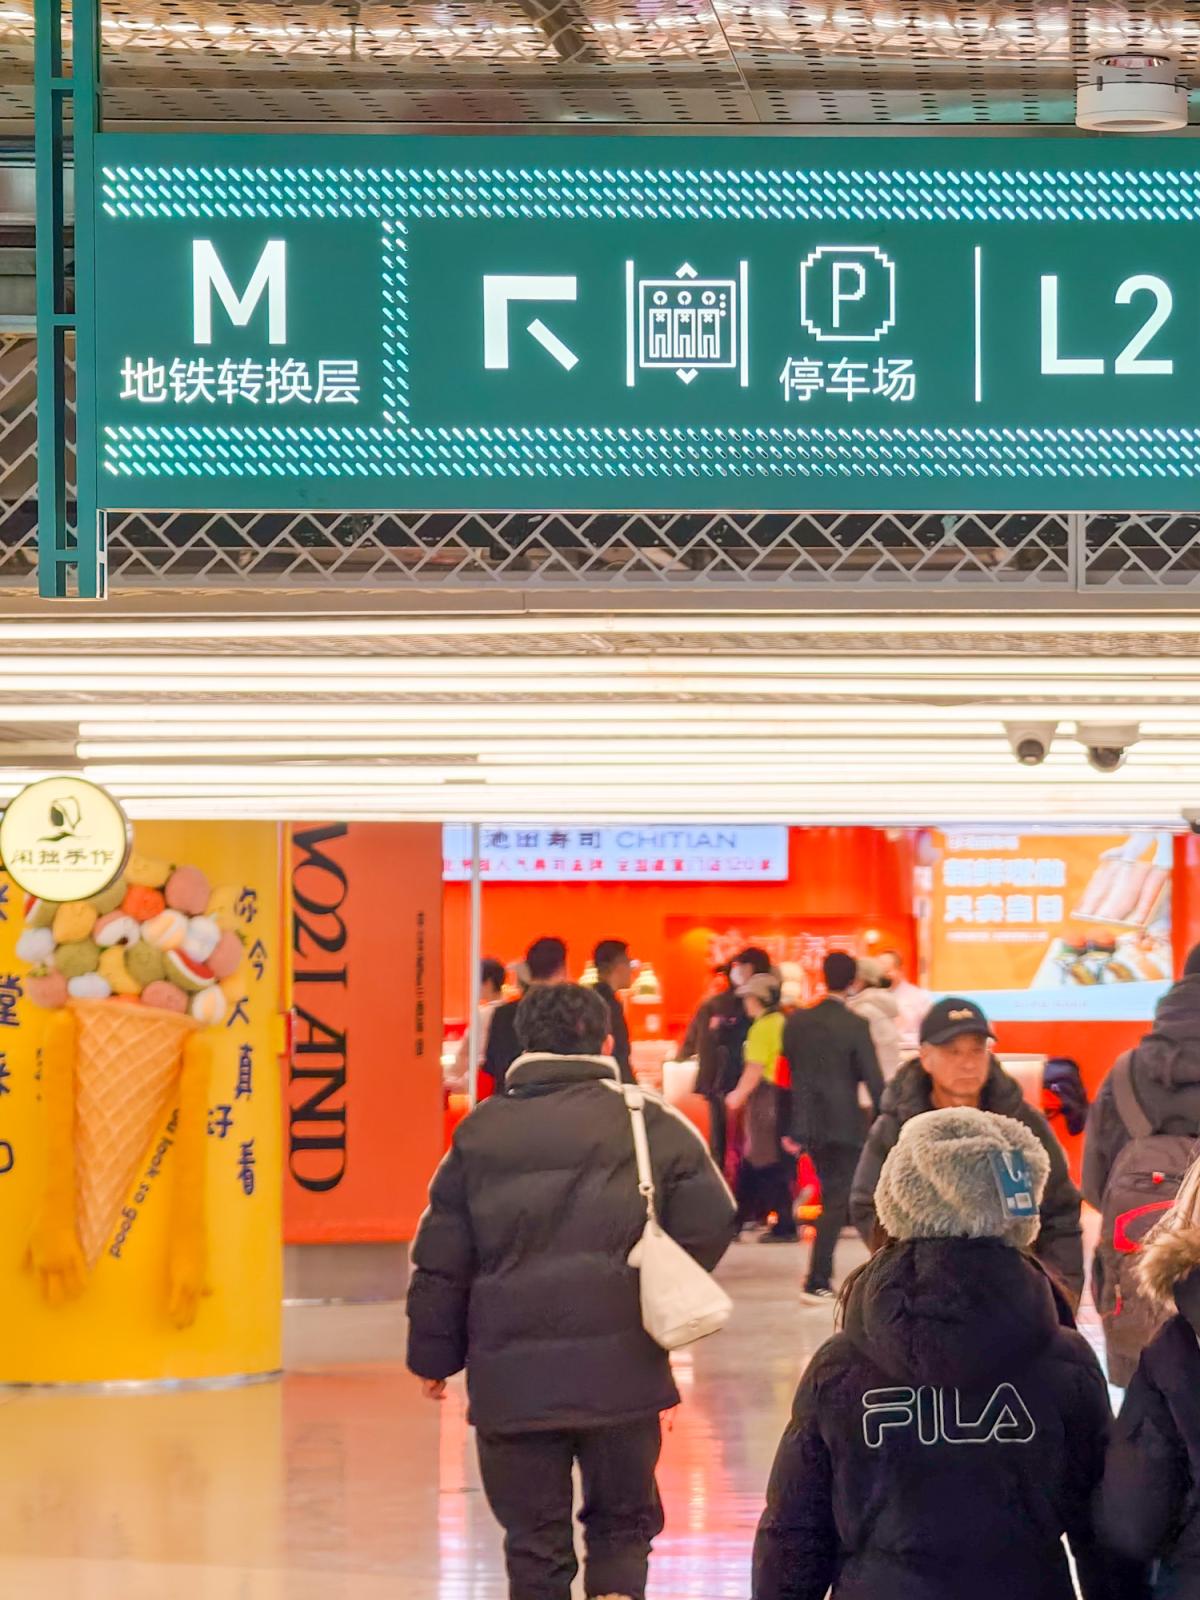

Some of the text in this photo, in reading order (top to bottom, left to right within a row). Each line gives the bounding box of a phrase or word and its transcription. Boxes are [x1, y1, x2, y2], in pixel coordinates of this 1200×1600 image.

[193, 239, 286, 345] M
[832, 262, 866, 328] P
[1040, 274, 1174, 375] L2
[119, 357, 361, 404] 地铁转换层
[779, 356, 917, 403] 停车场
[616, 831, 737, 849] CHITIAN
[146, 1138, 174, 1178] look
[134, 1183, 149, 1203] so
[109, 1206, 137, 1258] good
[862, 1382, 1036, 1448] FILA
